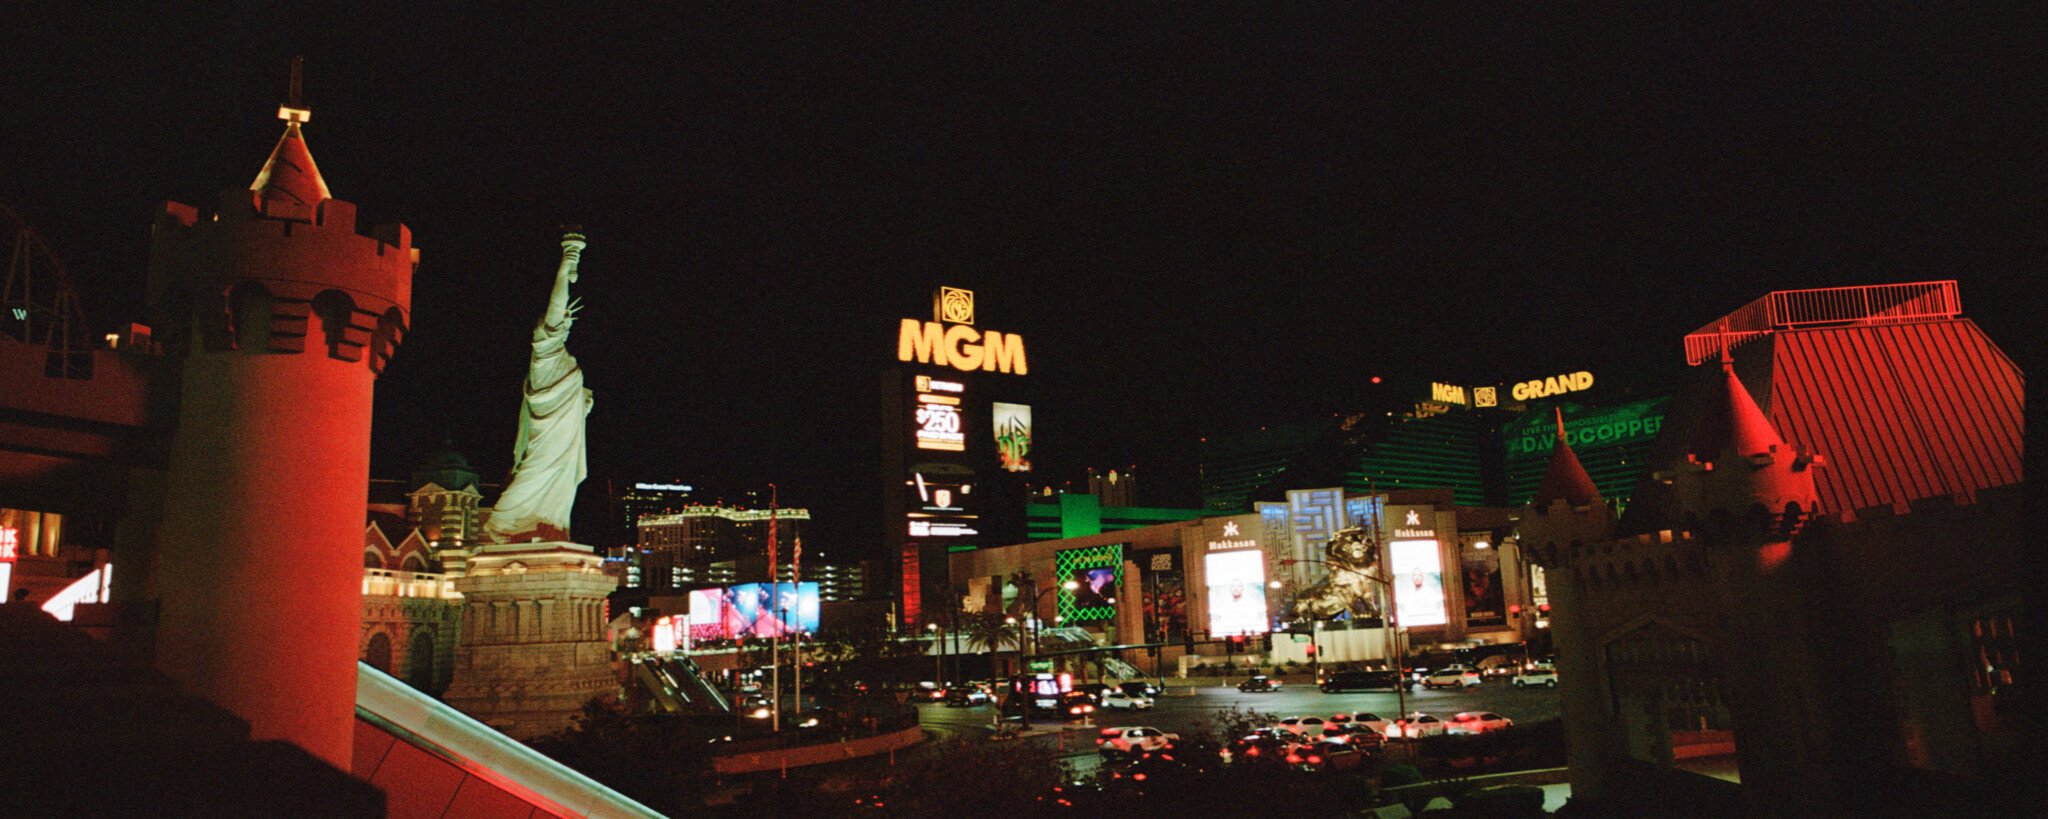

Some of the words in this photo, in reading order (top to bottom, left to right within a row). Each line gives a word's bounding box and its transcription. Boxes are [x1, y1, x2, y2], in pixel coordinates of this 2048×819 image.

[898, 318, 1028, 375] MGM
[1431, 382, 1466, 405] MGM
[1512, 371, 1594, 401] GRAND
[916, 408, 960, 433] $250
[1208, 539, 1257, 550] Hakkasan
